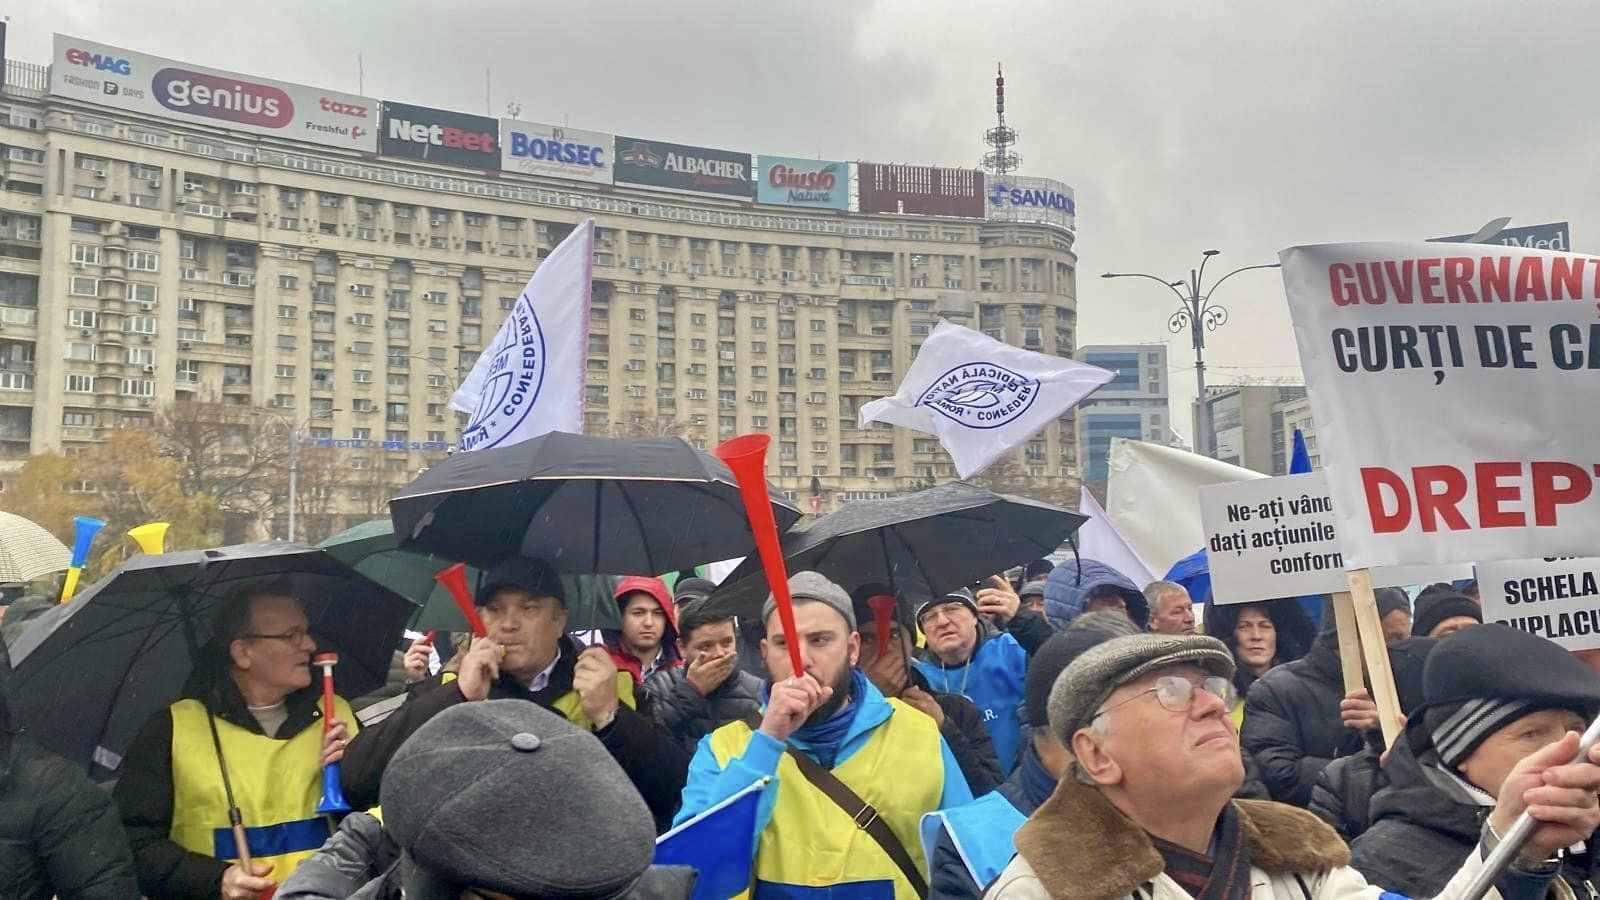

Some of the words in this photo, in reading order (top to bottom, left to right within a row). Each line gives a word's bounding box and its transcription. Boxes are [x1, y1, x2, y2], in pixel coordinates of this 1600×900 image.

[167, 79, 280, 118] genius
[320, 97, 368, 118] tazz
[305, 121, 349, 136] Freshful
[389, 118, 495, 153] NetBet
[510, 131, 605, 168] BORSEC
[769, 163, 837, 191] Giusto
[787, 189, 832, 202] Natura
[1331, 325, 1464, 385] CURȚI
[1474, 324, 1538, 369] DE
[1227, 496, 1285, 525] Ne-ați
[1360, 461, 1600, 534] DREP
[1210, 529, 1247, 557] dați
[1251, 521, 1335, 552] acțiunile
[1503, 571, 1599, 605] SCHELA
